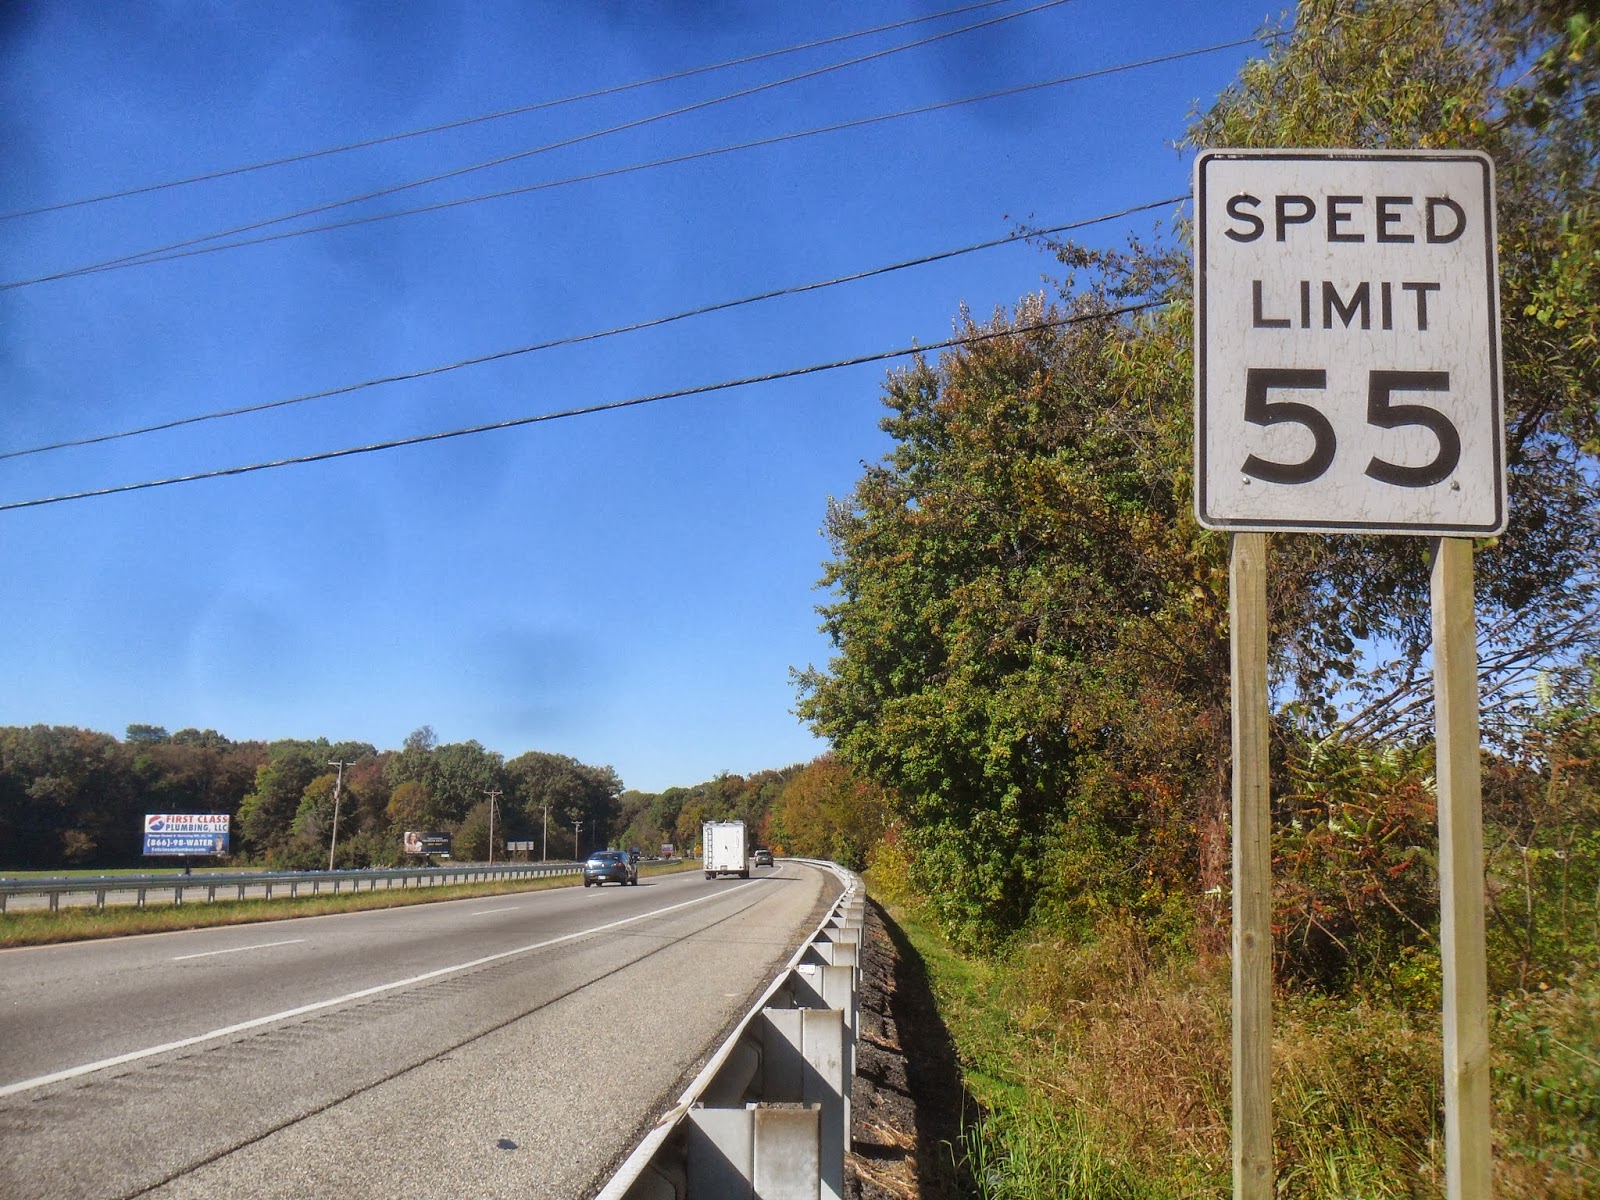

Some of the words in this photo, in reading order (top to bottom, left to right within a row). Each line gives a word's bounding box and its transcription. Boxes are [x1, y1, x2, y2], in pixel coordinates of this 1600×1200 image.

[1224, 195, 1467, 244] SPEED
[1252, 280, 1441, 331] LIMIT
[1240, 368, 1461, 488] 55
[165, 815, 194, 823] FIRST
[197, 815, 227, 823] CLASS
[165, 824, 211, 832] PLUMBING,
[147, 838, 213, 847] (866)-98-WATER
